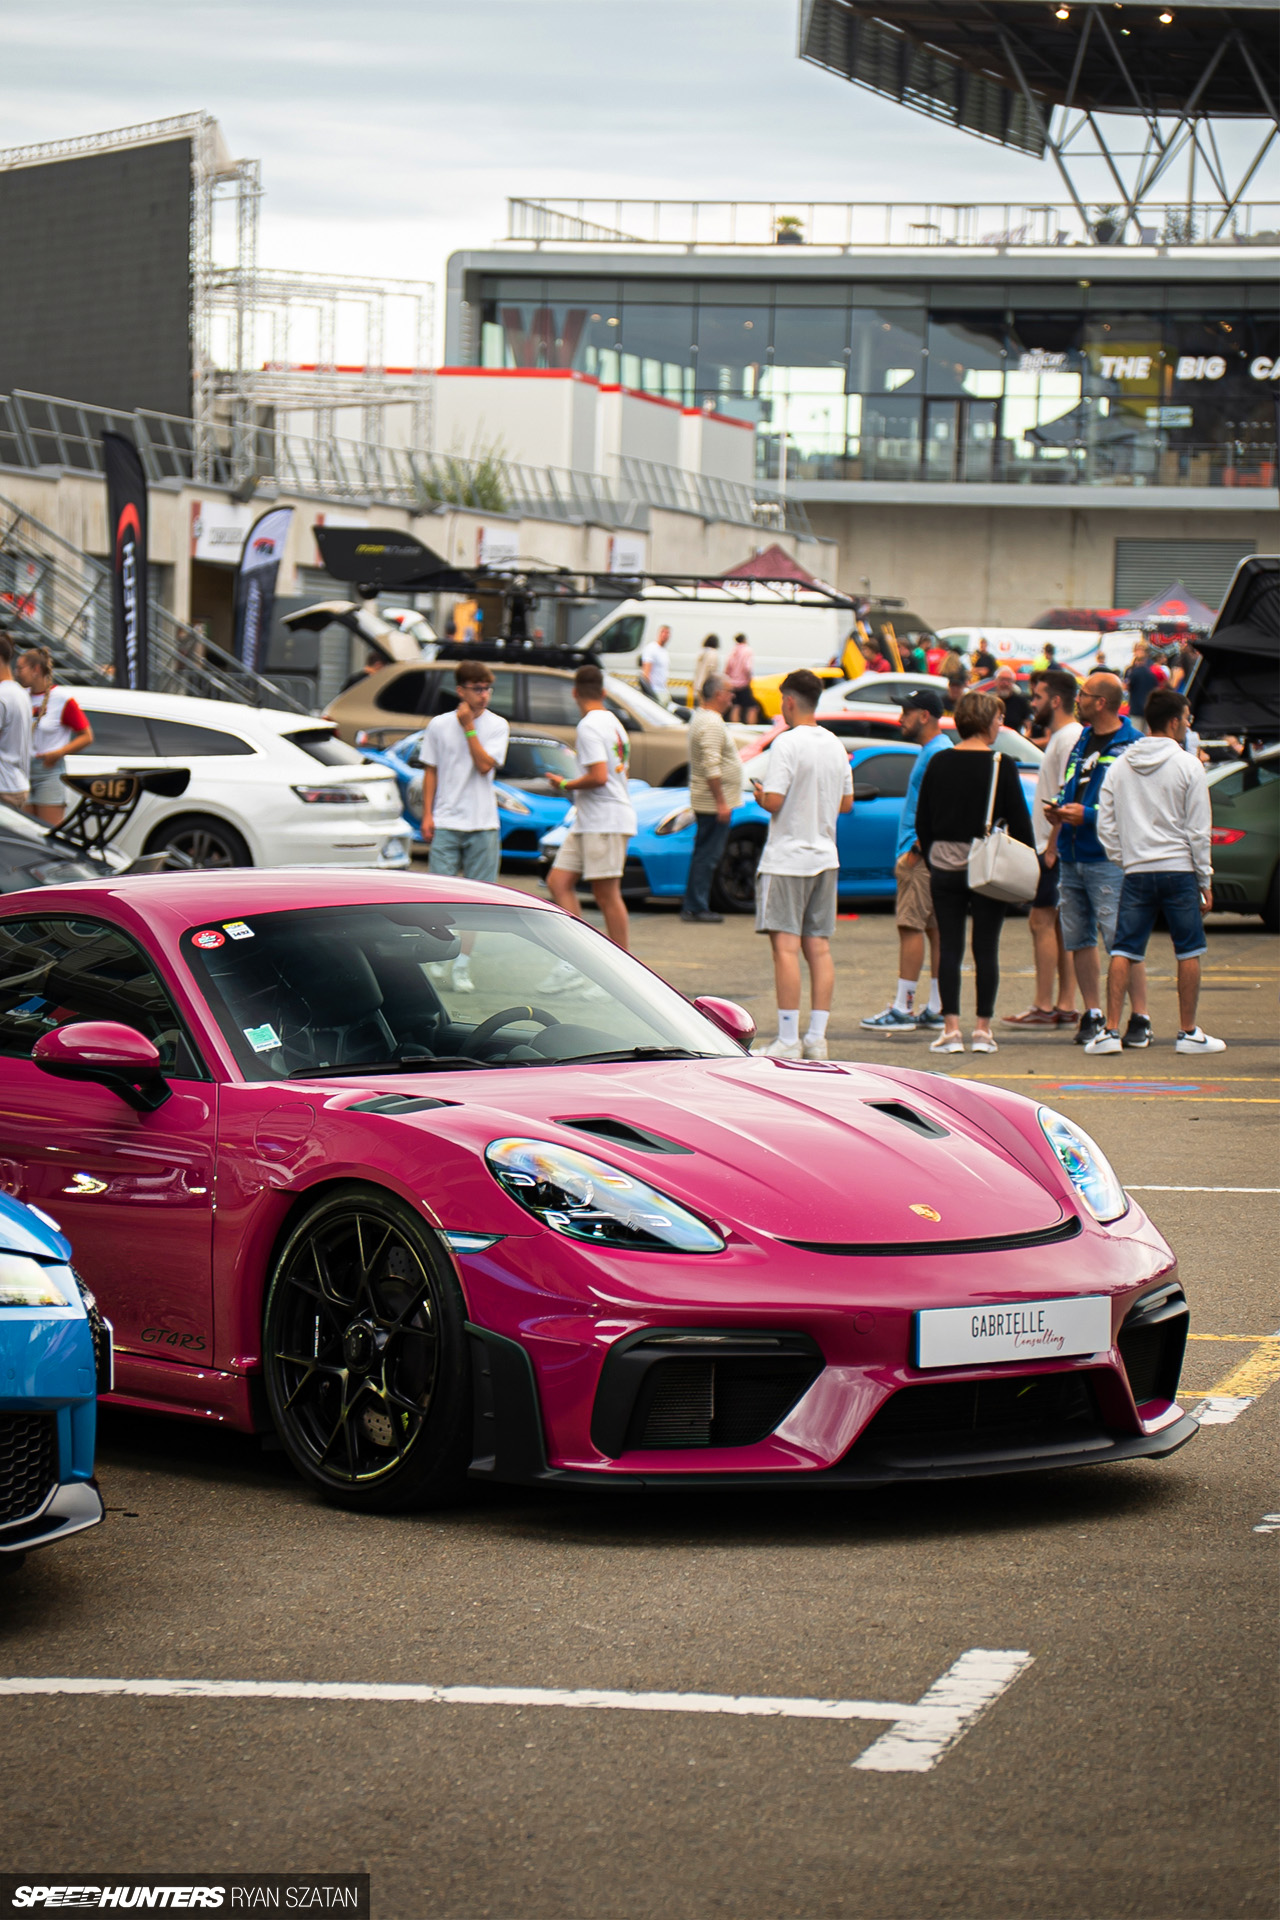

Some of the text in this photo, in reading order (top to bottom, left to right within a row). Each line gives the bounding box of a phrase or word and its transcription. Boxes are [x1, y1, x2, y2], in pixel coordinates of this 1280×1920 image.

[1100, 356, 1151, 379] THE
[1176, 356, 1226, 380] BIG
[90, 780, 127, 799] elf
[971, 1310, 1045, 1338] GABRIELLE
[141, 1328, 206, 1350] GT4RS
[1014, 1328, 1065, 1351] Consulting
